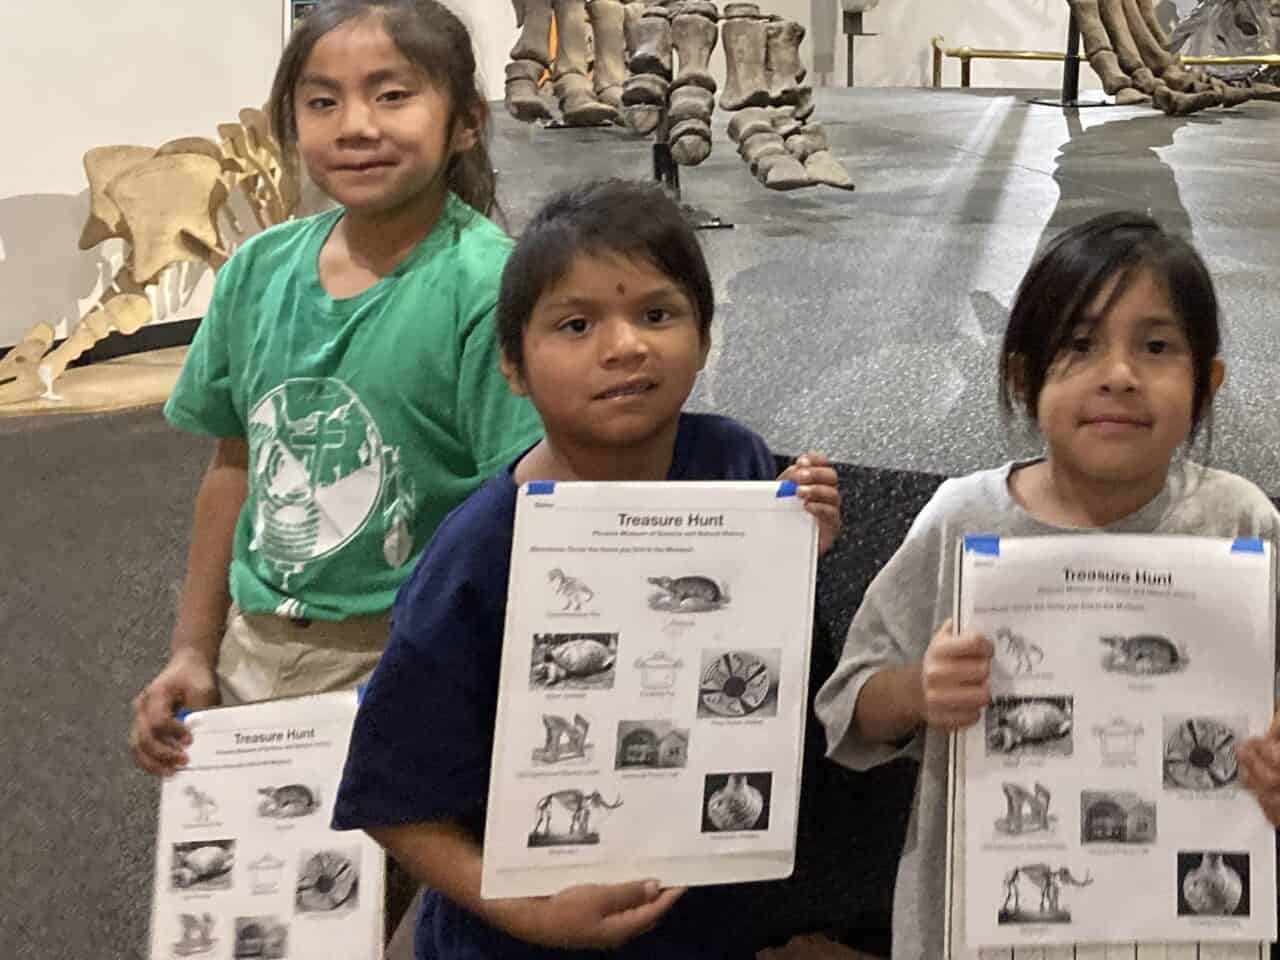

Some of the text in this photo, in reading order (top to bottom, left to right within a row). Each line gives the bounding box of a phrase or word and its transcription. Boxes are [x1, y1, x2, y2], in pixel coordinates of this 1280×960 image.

[617, 512, 724, 527] Treasure Hunt
[1063, 567, 1173, 585] Treasure Hunt
[233, 727, 316, 745] Treasure Hunt
